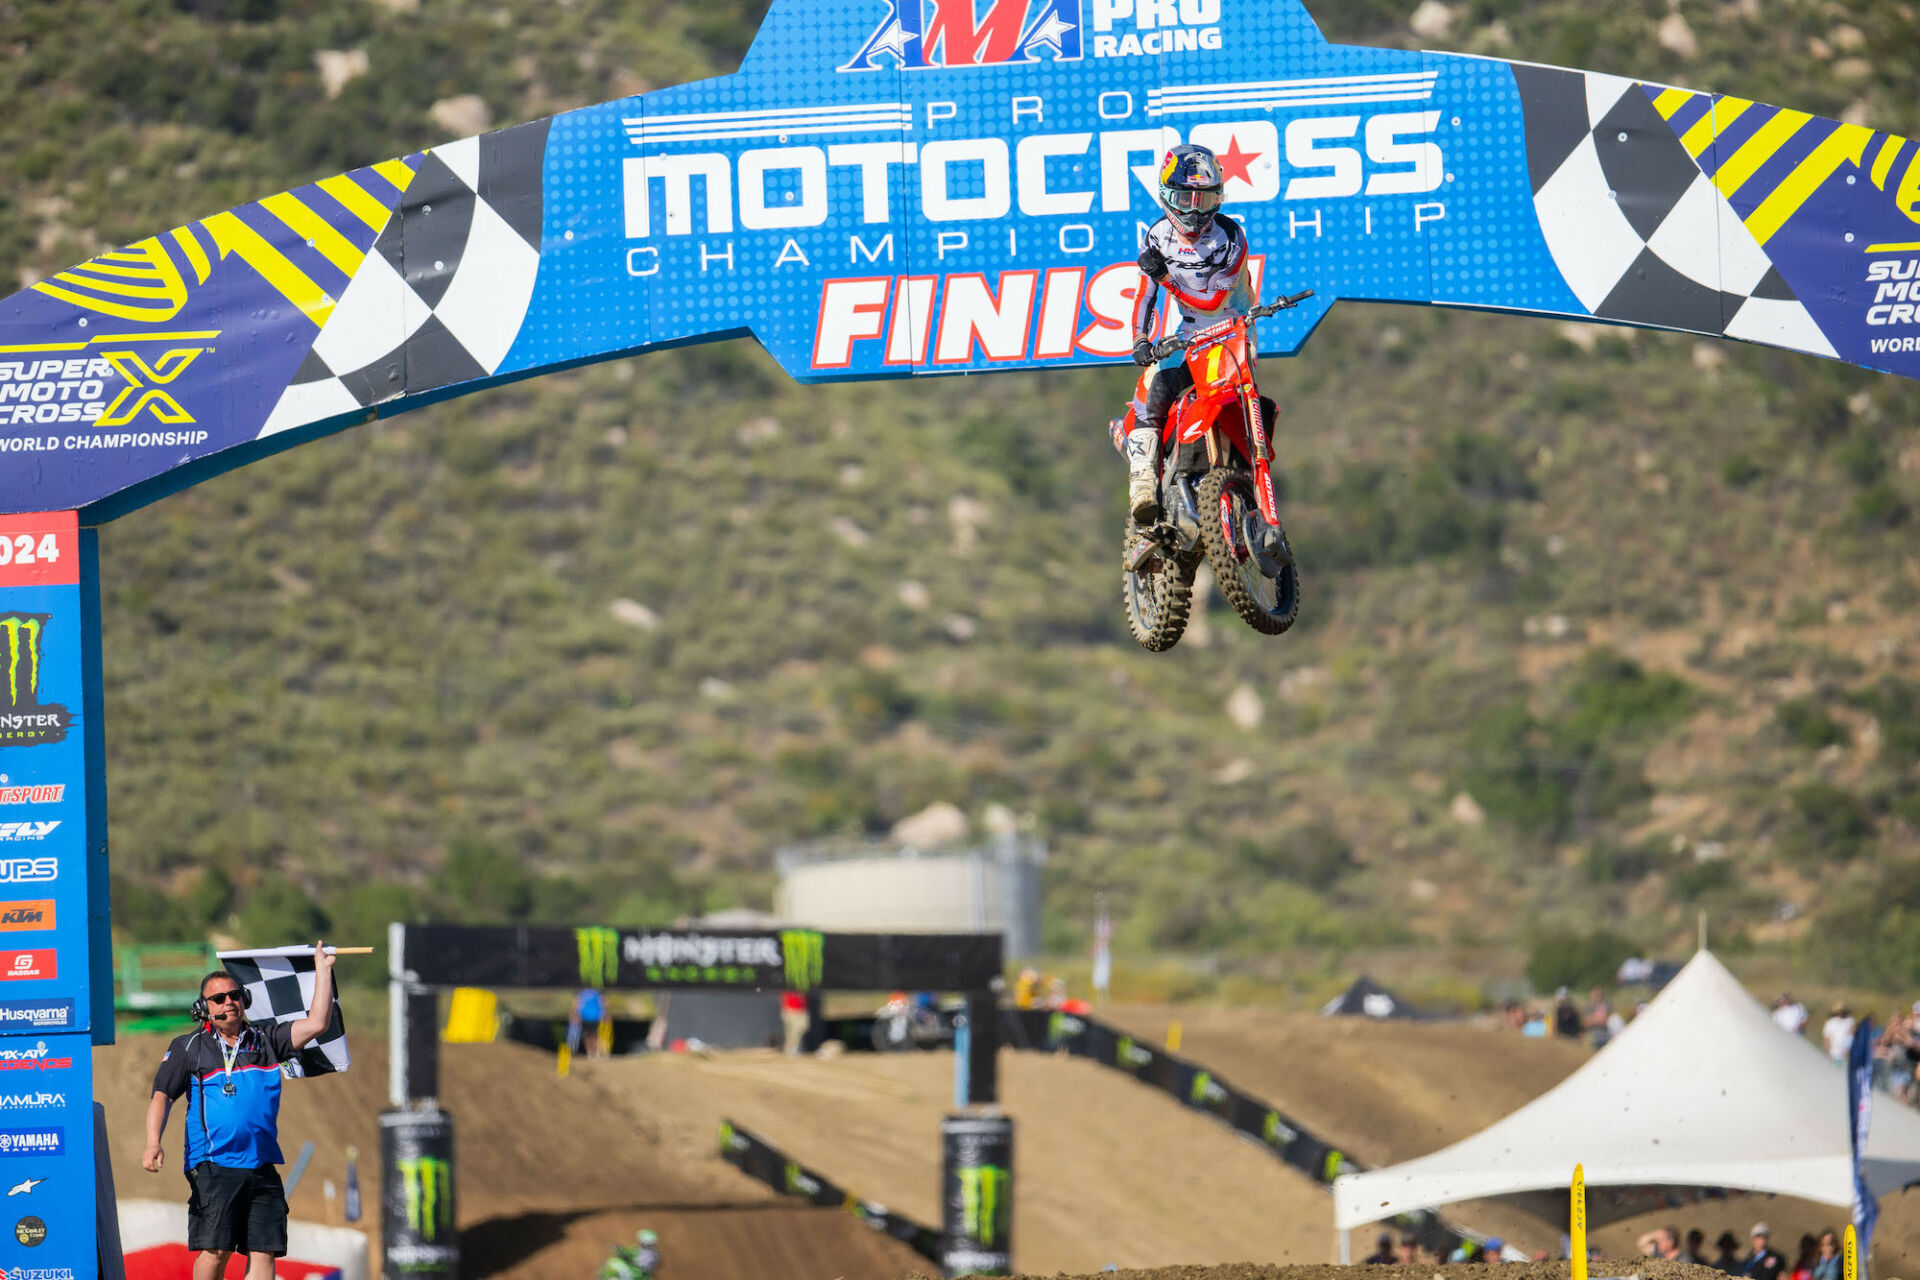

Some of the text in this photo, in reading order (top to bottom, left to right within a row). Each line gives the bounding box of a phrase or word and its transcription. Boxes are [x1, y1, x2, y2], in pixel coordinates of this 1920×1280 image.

[1092, 0, 1221, 31] PRO
[1093, 27, 1222, 58] RACING
[926, 91, 1133, 129] PRO
[622, 110, 1444, 239] MOTOCROSS
[1865, 259, 1920, 282] SU
[0, 358, 111, 381] SUPER
[1206, 344, 1224, 384] 1
[0, 380, 104, 402] MOTO
[0, 430, 209, 452] WORLD CHAMPIONSHIP
[1, 909, 43, 923] KTM
[0, 1007, 67, 1022] Husqvarna
[0, 1092, 65, 1106] AMURA
[12, 1133, 59, 1147] YAMAHA
[9, 1268, 73, 1280] SUZUKI
